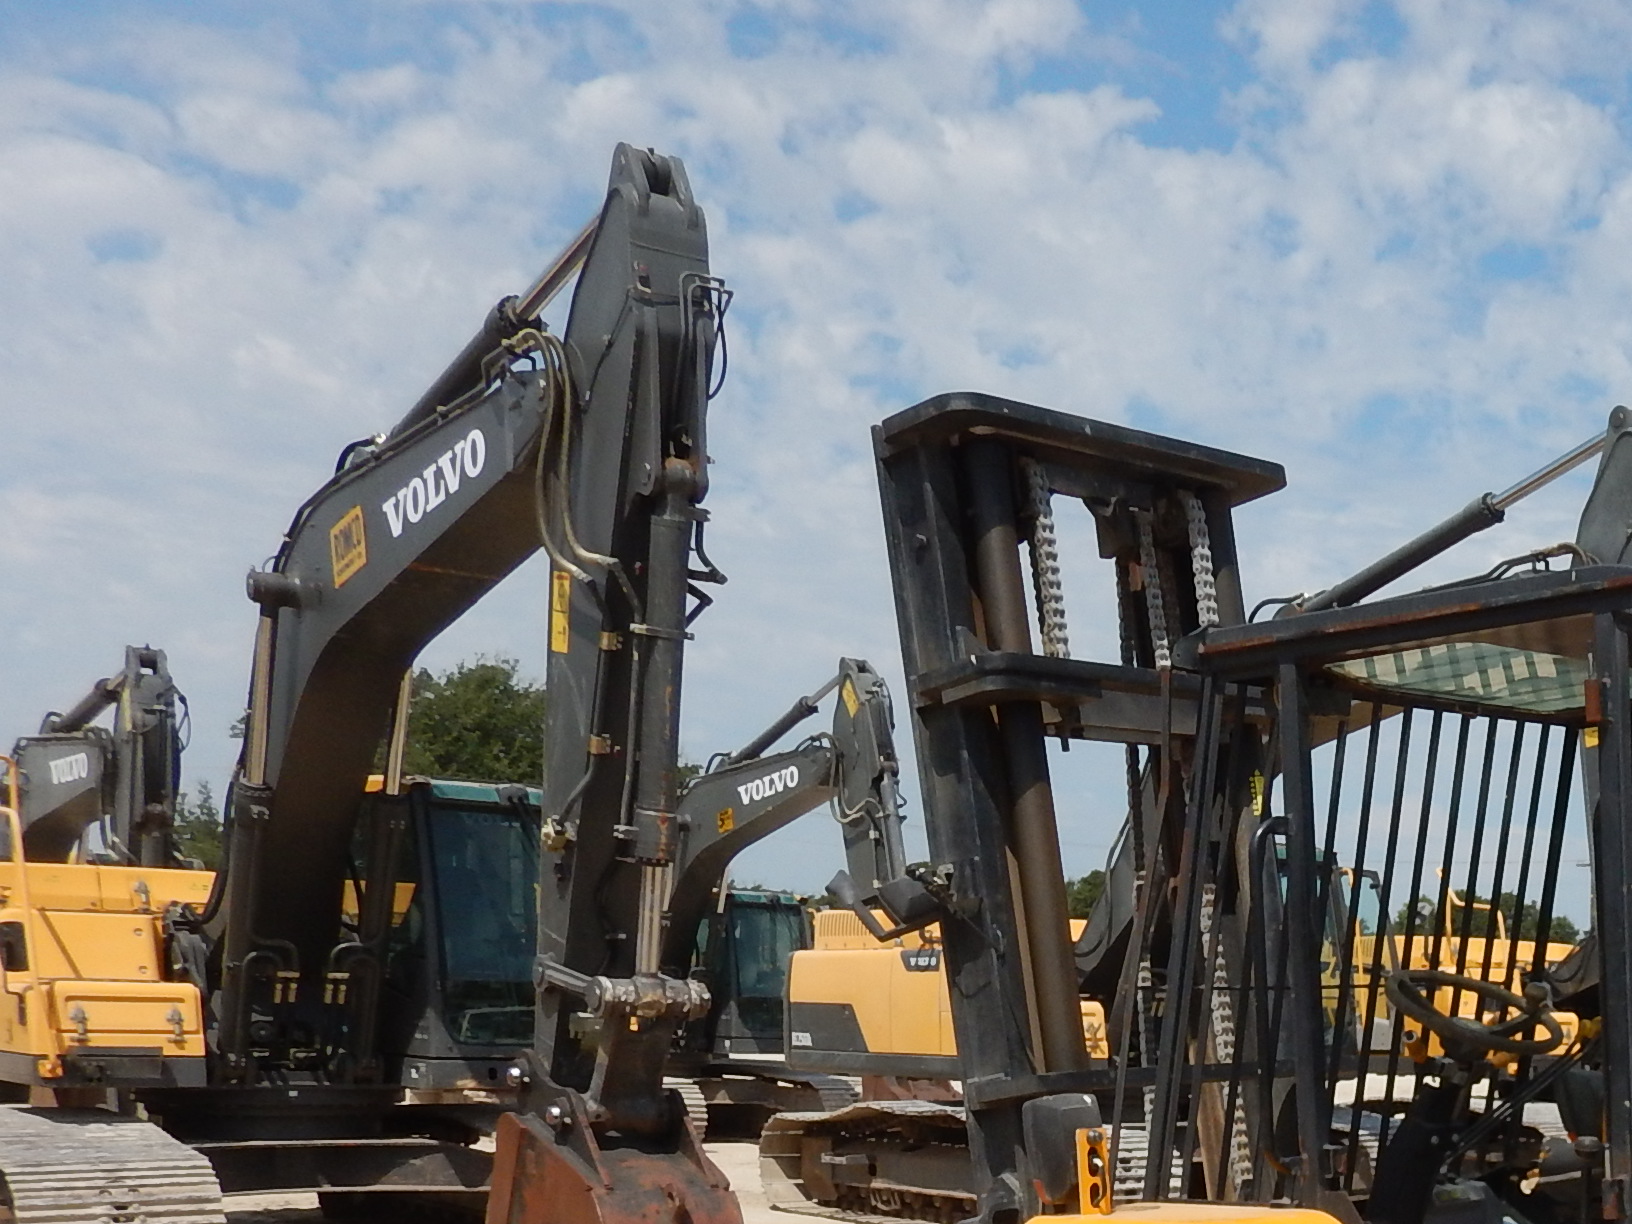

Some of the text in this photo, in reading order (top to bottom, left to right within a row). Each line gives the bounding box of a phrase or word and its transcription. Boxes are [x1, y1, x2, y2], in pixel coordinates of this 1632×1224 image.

[382, 429, 486, 538] VOLVO
[49, 752, 88, 784] VOLVO
[737, 765, 799, 805] VOLVO
